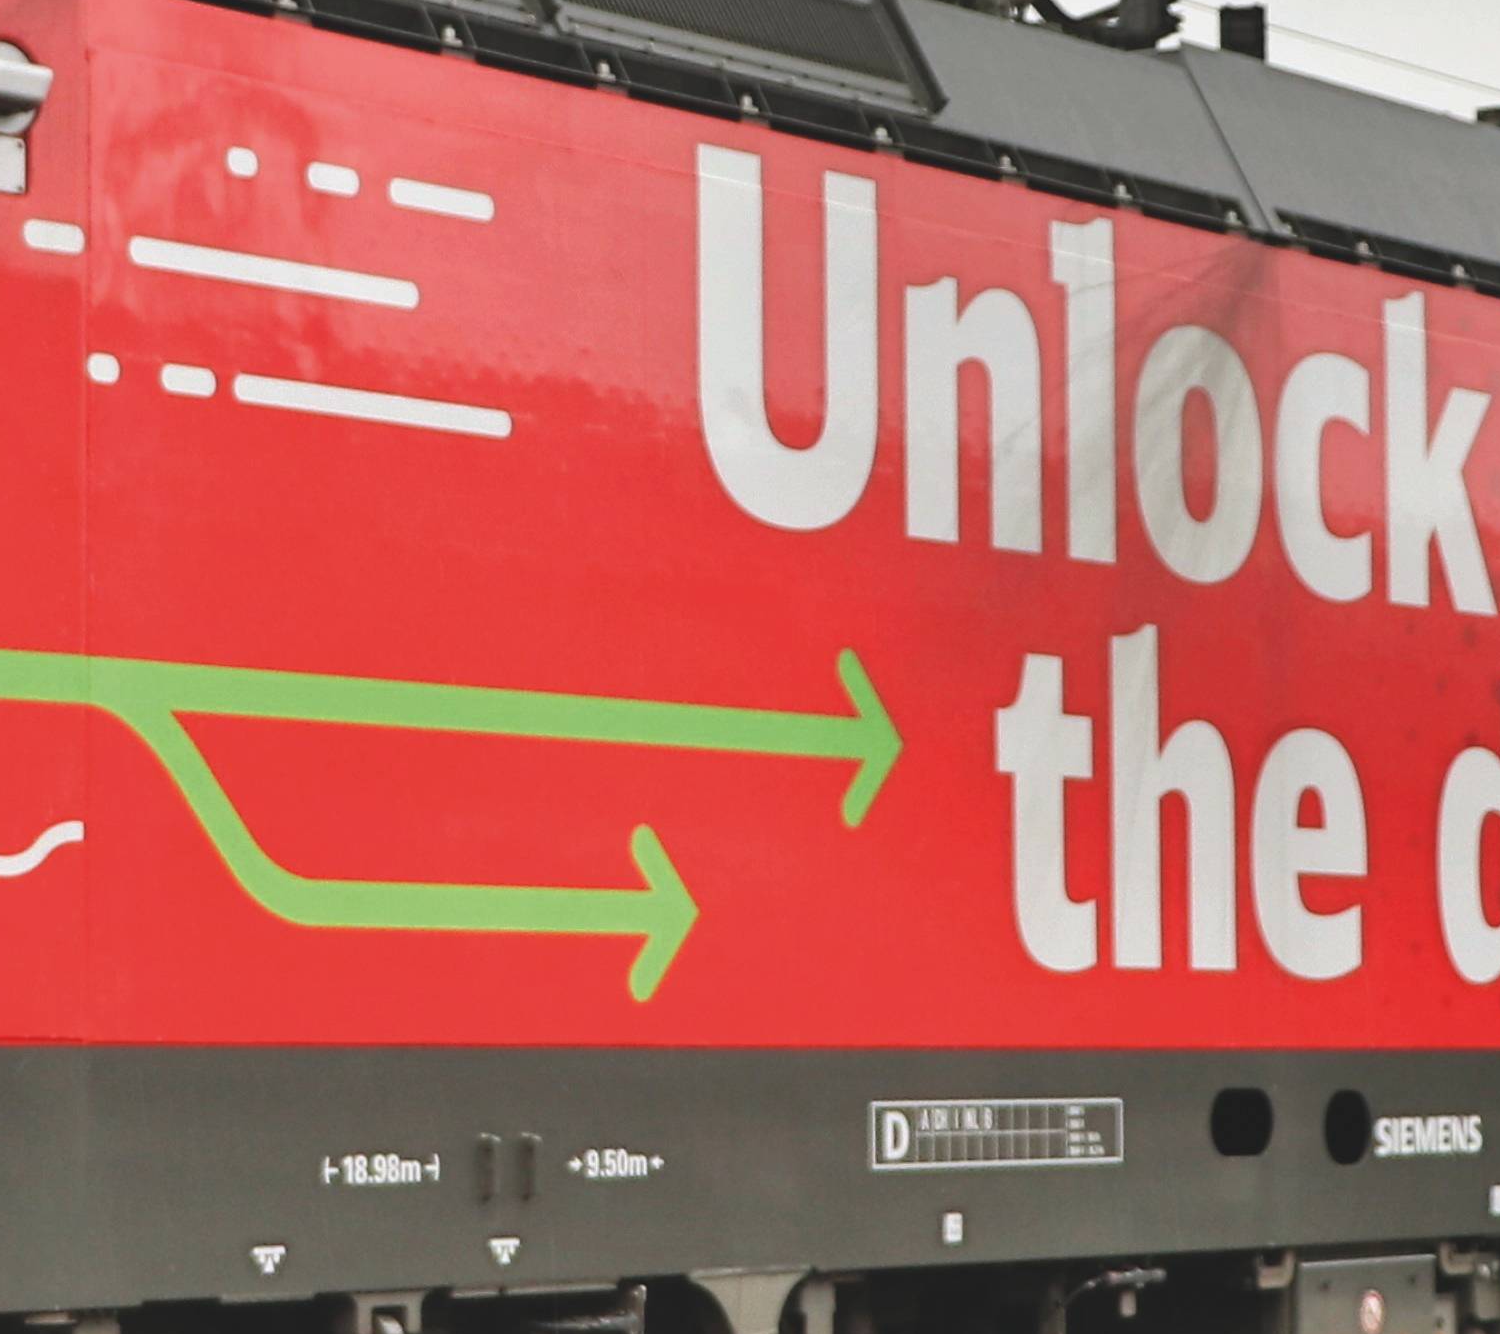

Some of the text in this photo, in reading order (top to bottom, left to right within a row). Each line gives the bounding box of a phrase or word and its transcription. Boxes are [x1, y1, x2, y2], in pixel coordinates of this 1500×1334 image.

[696, 143, 1497, 616] Unlock
[996, 624, 1368, 980] the
[883, 1110, 910, 1160] D
[1373, 1114, 1484, 1157] SIEMENS
[342, 1153, 422, 1185] 18.98m
[584, 1148, 649, 1179] 9.50m
